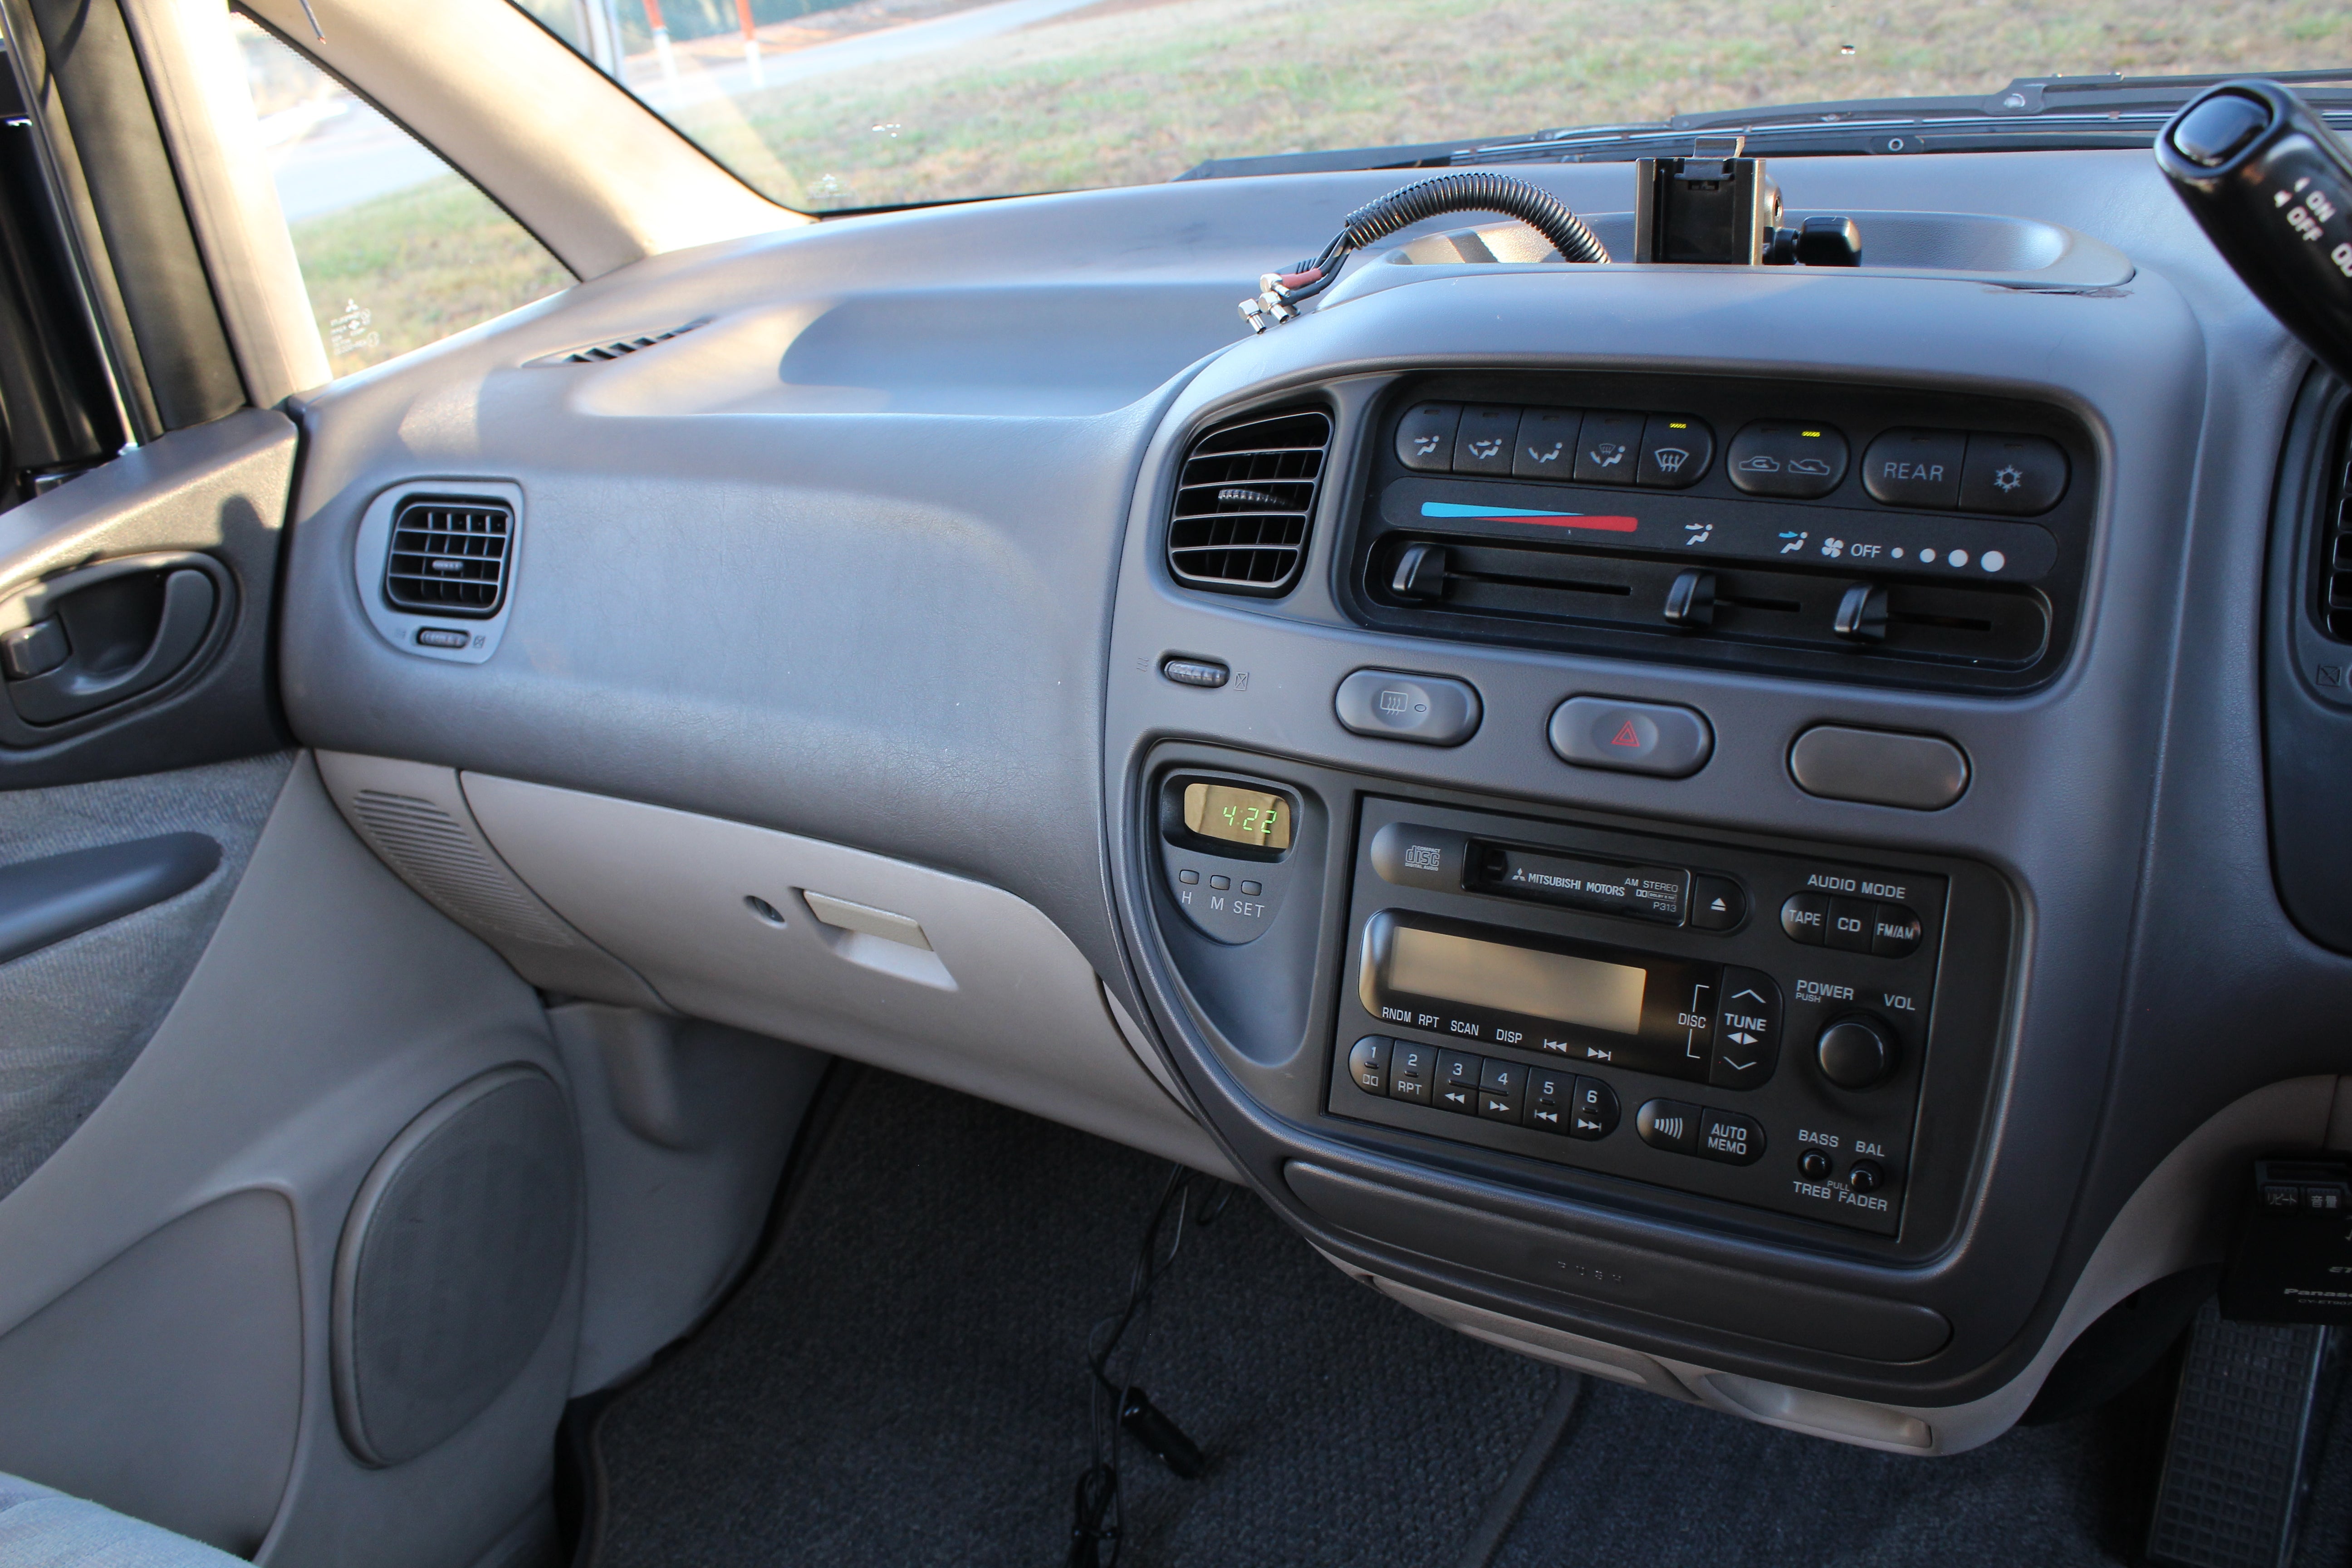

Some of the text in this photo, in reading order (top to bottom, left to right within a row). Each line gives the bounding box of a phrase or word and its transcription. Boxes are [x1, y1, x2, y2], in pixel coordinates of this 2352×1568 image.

[2306, 190, 2337, 223] ON
[2287, 206, 2324, 241] OFF
[1884, 462, 1944, 482] REAR
[1851, 544, 1882, 559] OFF
[1223, 806, 1277, 833] 4:22
[1528, 873, 1625, 897] MITSUBISHI MOTORS
[1624, 878, 1678, 893] AM STEREO
[1808, 874, 1906, 899] AUDIO MODE
[1181, 891, 1192, 905] H
[1210, 896, 1224, 911] M
[1233, 900, 1265, 918] SET
[1653, 902, 1676, 912] P313
[1789, 909, 1822, 926] TAPE
[1838, 917, 1861, 932] CD
[1877, 923, 1915, 941] FM/AM
[1795, 992, 1821, 1003] PUSH
[1796, 979, 1854, 1000] POWER
[1884, 994, 1916, 1011] VOL
[1382, 1006, 1411, 1023] RNDM
[1418, 1014, 1440, 1028] RPT
[1678, 1012, 1706, 1029] DISC
[1725, 1013, 1767, 1032] TUNE
[1450, 1020, 1479, 1036] SCAN
[1496, 1029, 1523, 1044] DISP
[1371, 1046, 1377, 1058] 1
[1407, 1054, 1418, 1067] 2
[1452, 1063, 1463, 1076] 3
[1498, 1073, 1508, 1085] 4
[1398, 1080, 1422, 1095] RPT
[1544, 1082, 1554, 1095] 5
[1588, 1090, 1598, 1104] 6
[1711, 1123, 1747, 1141] AUTO
[1798, 1129, 1839, 1148] BASS
[1707, 1137, 1746, 1155] MEMO
[1855, 1141, 1886, 1157] BAL
[1793, 1181, 1832, 1200] TREB
[1827, 1181, 1850, 1192] PULL
[1838, 1191, 1889, 1212] FADER
[2268, 1193, 2297, 1205] リピート
[2311, 1195, 2337, 1208] 音量
